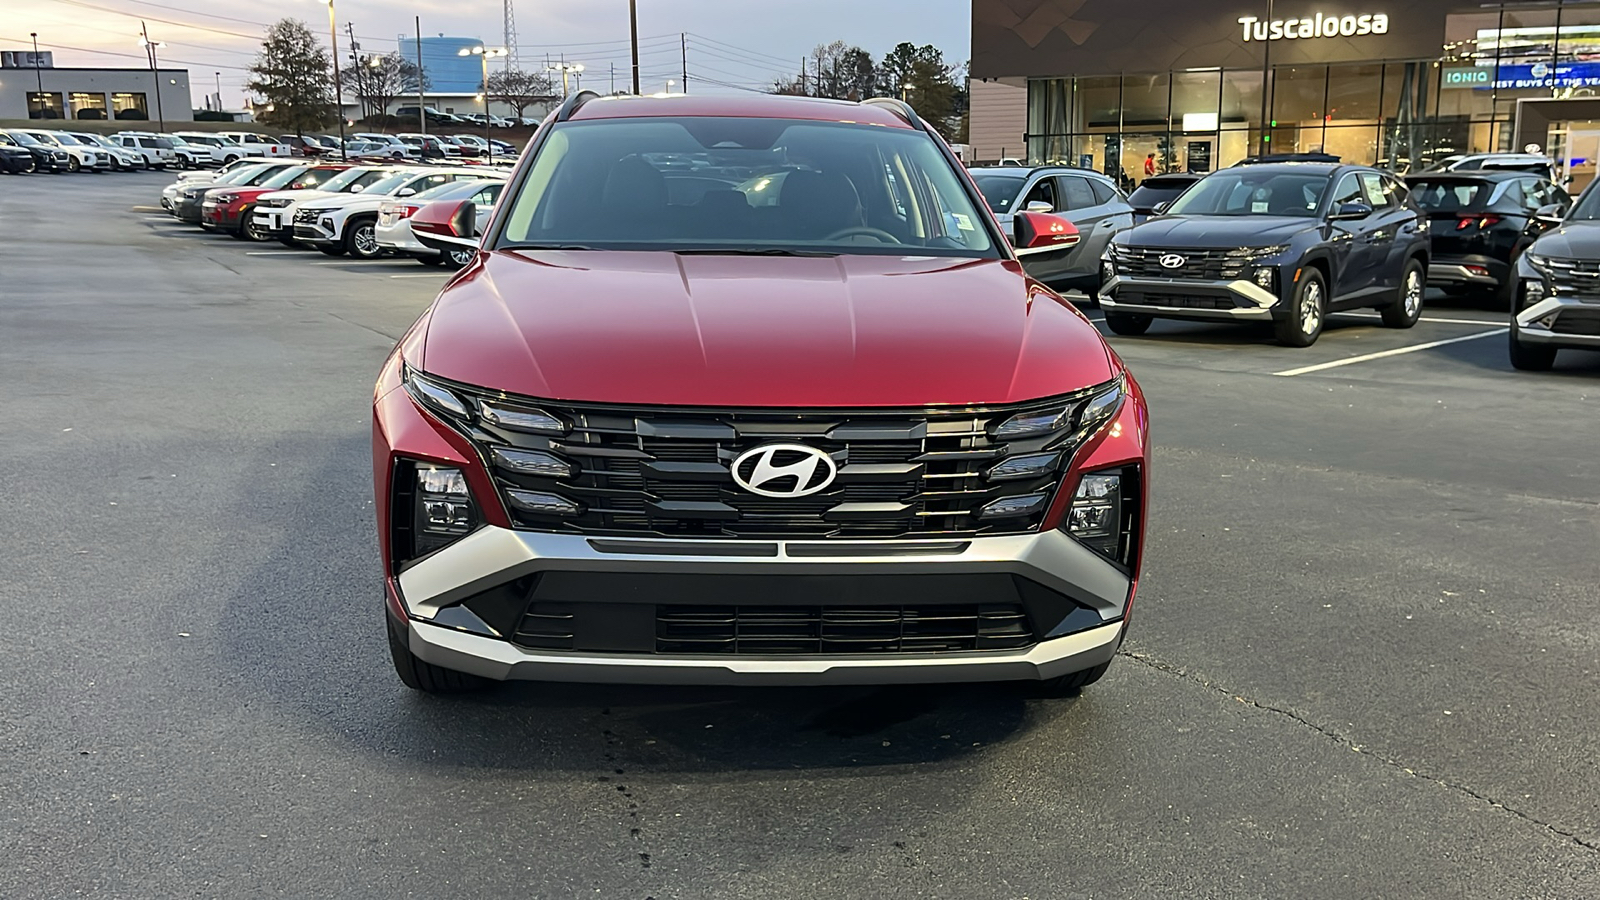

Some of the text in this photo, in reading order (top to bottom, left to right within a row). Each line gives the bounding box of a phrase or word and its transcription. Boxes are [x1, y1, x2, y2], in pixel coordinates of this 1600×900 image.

[1237, 12, 1389, 42] Tuscaloosa
[1447, 71, 1488, 83] IONIQ
[1515, 79, 1543, 88] BUYS
[1544, 78, 1561, 87] OF
[1562, 78, 1582, 86] THE
